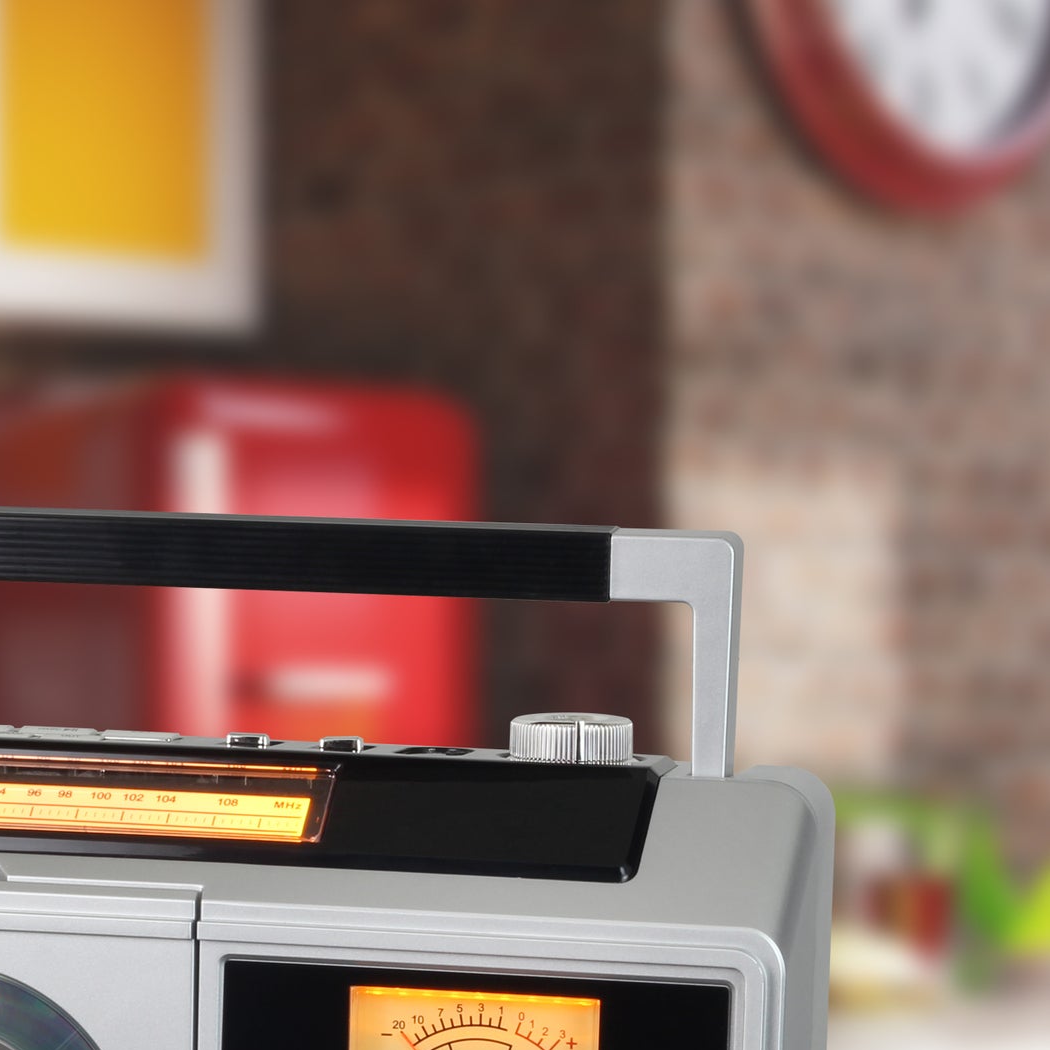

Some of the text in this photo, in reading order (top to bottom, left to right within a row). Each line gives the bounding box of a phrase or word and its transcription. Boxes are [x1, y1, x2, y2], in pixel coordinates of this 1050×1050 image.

[26, 788, 42, 797] 96
[57, 789, 73, 799] 98
[90, 791, 112, 800] 100
[123, 793, 144, 802] 102
[156, 794, 176, 804] 104
[217, 798, 238, 807] 108
[273, 801, 302, 810] MHz
[392, 1020, 406, 1030] 20
[412, 1015, 424, 1025] 10
[437, 1008, 444, 1017] 7
[456, 1003, 463, 1013] 5
[478, 1002, 485, 1012] 3
[518, 1011, 525, 1021] 0
[542, 1027, 549, 1037] 2
[559, 1029, 566, 1039] 3
